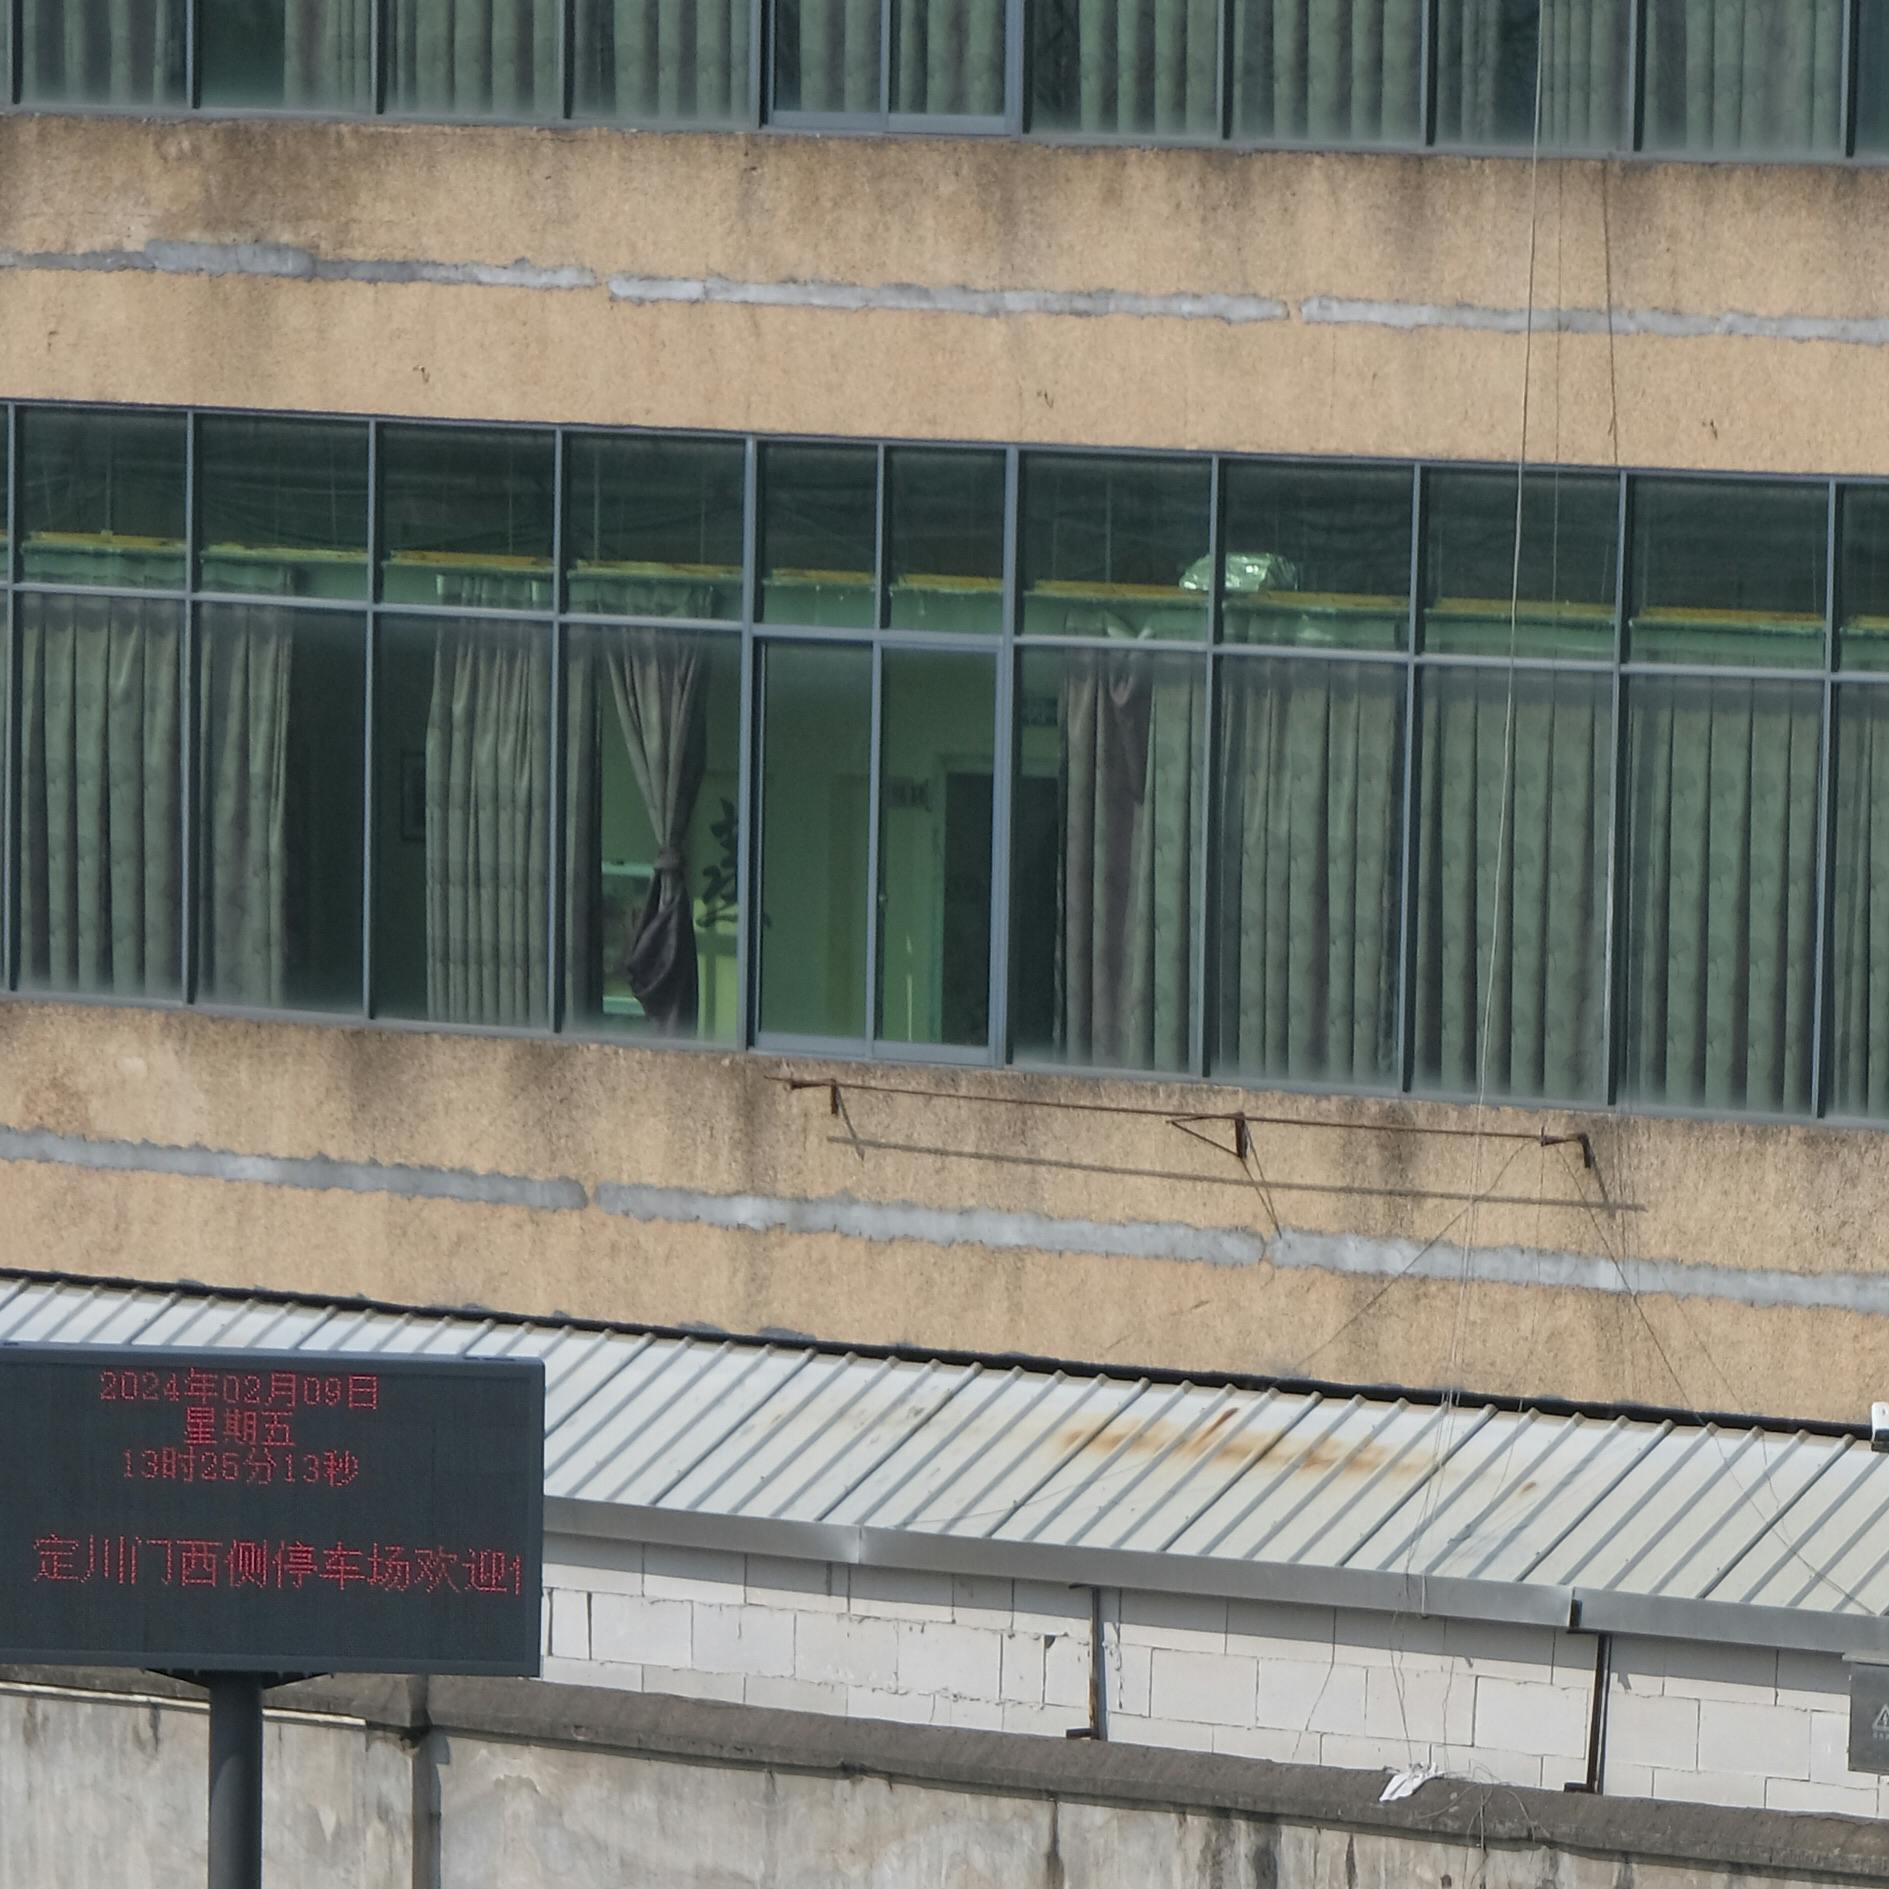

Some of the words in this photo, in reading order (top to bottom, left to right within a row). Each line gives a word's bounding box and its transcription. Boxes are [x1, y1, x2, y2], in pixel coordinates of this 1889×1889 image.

[99, 1367, 379, 1410] 2024年02月09日
[184, 1406, 296, 1447] 星期五
[121, 1447, 360, 1487] 13时25分13秒
[33, 1533, 522, 1596] 定川门西侧停车场欢迎
